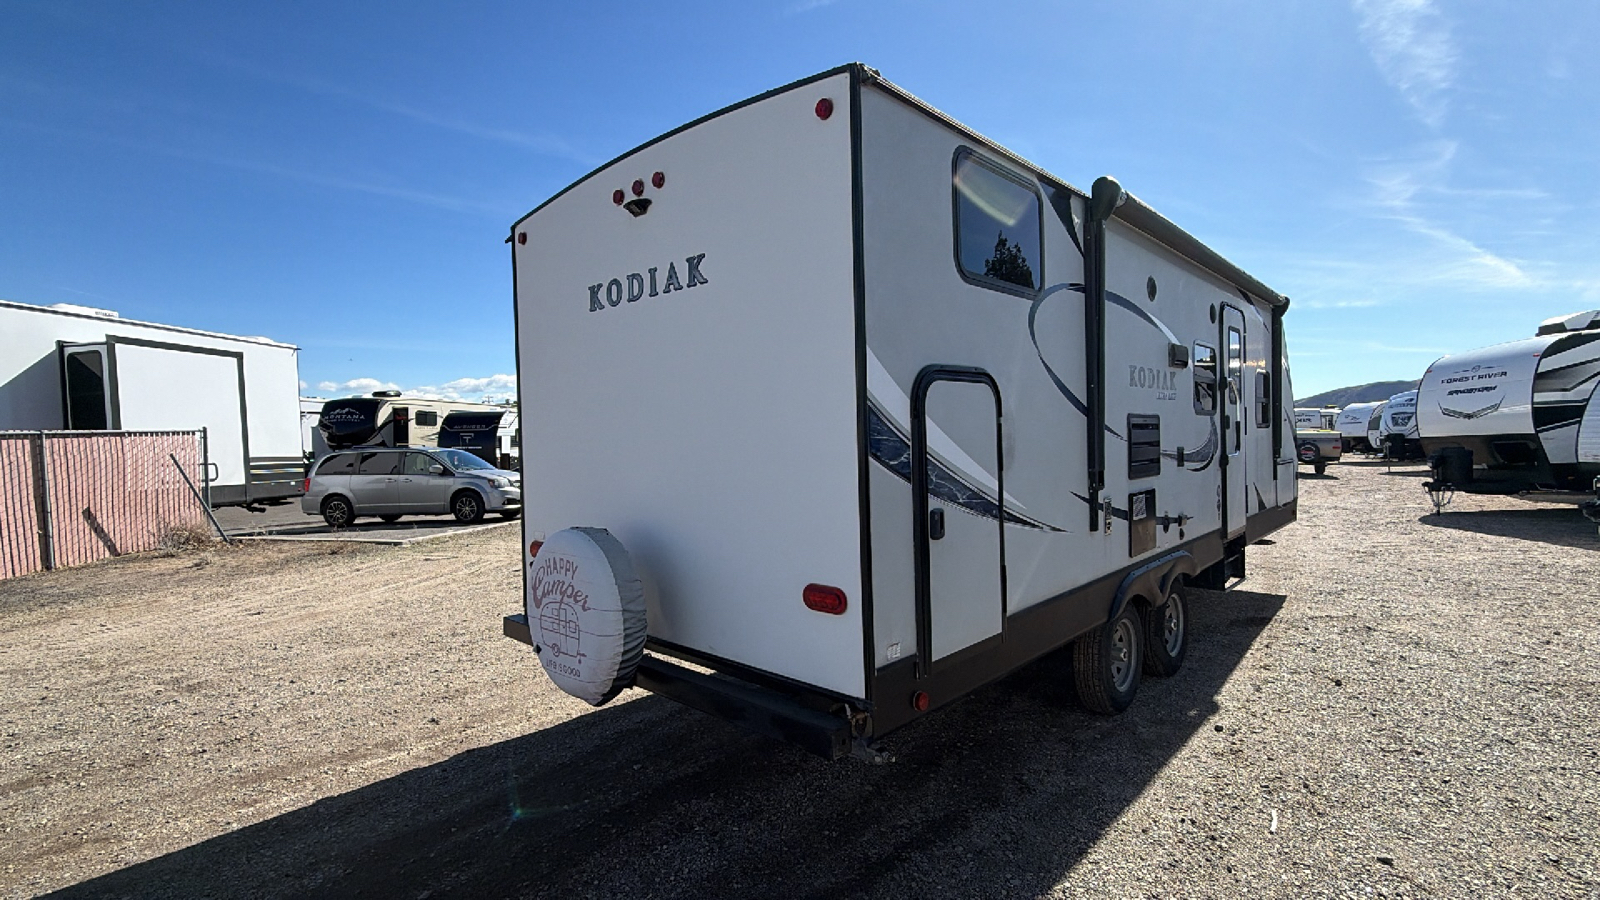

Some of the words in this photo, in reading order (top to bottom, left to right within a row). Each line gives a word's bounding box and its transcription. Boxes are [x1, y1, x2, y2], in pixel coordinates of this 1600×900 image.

[588, 253, 708, 312] KODIAK
[1128, 364, 1177, 391] KODIAK
[1441, 375, 1477, 384] FOREST
[1478, 371, 1507, 381] RIVER
[545, 556, 578, 580] HAPPY
[532, 566, 592, 612] Camper
